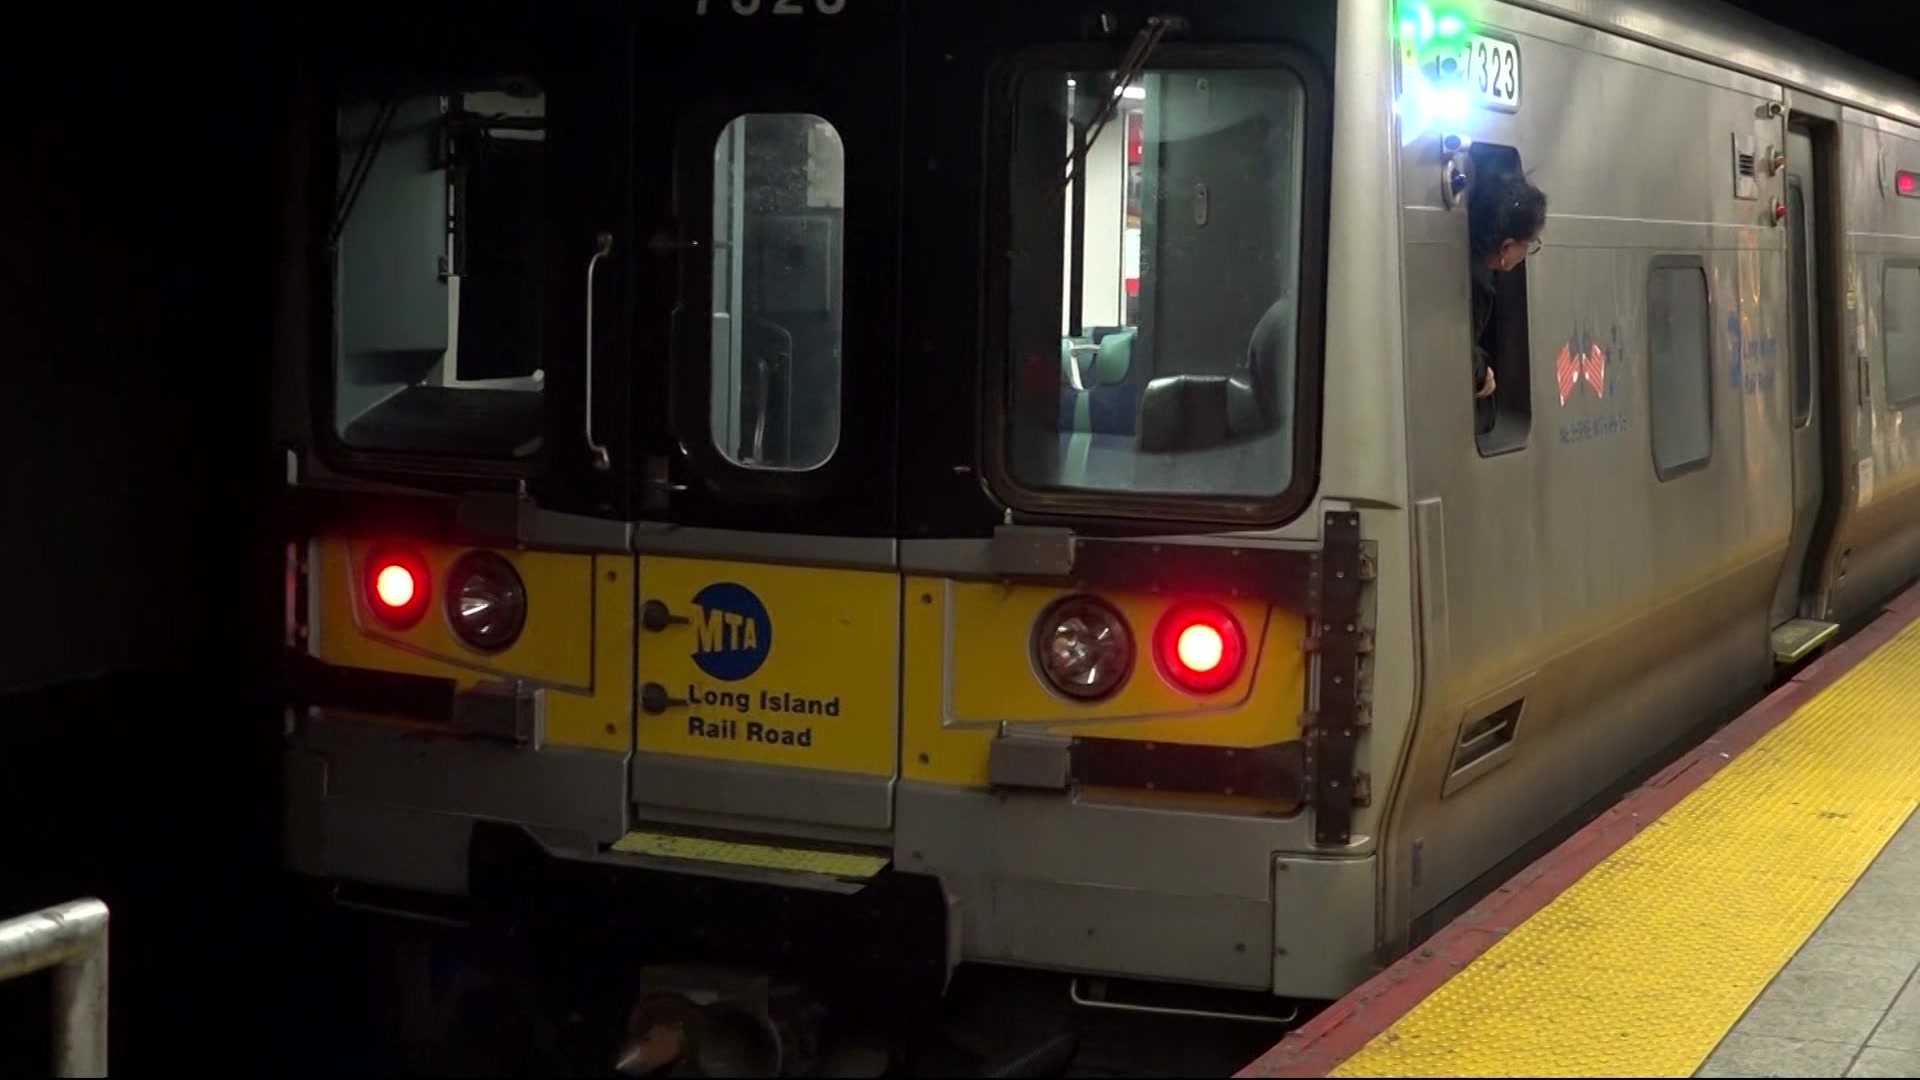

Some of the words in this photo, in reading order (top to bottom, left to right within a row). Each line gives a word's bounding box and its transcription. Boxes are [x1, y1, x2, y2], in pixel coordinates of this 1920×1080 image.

[1464, 41, 1515, 100] 7323
[692, 604, 757, 653] MTA
[688, 683, 750, 713] Long
[760, 690, 840, 717] Island
[688, 716, 736, 740] Rail
[746, 721, 812, 747] Road
